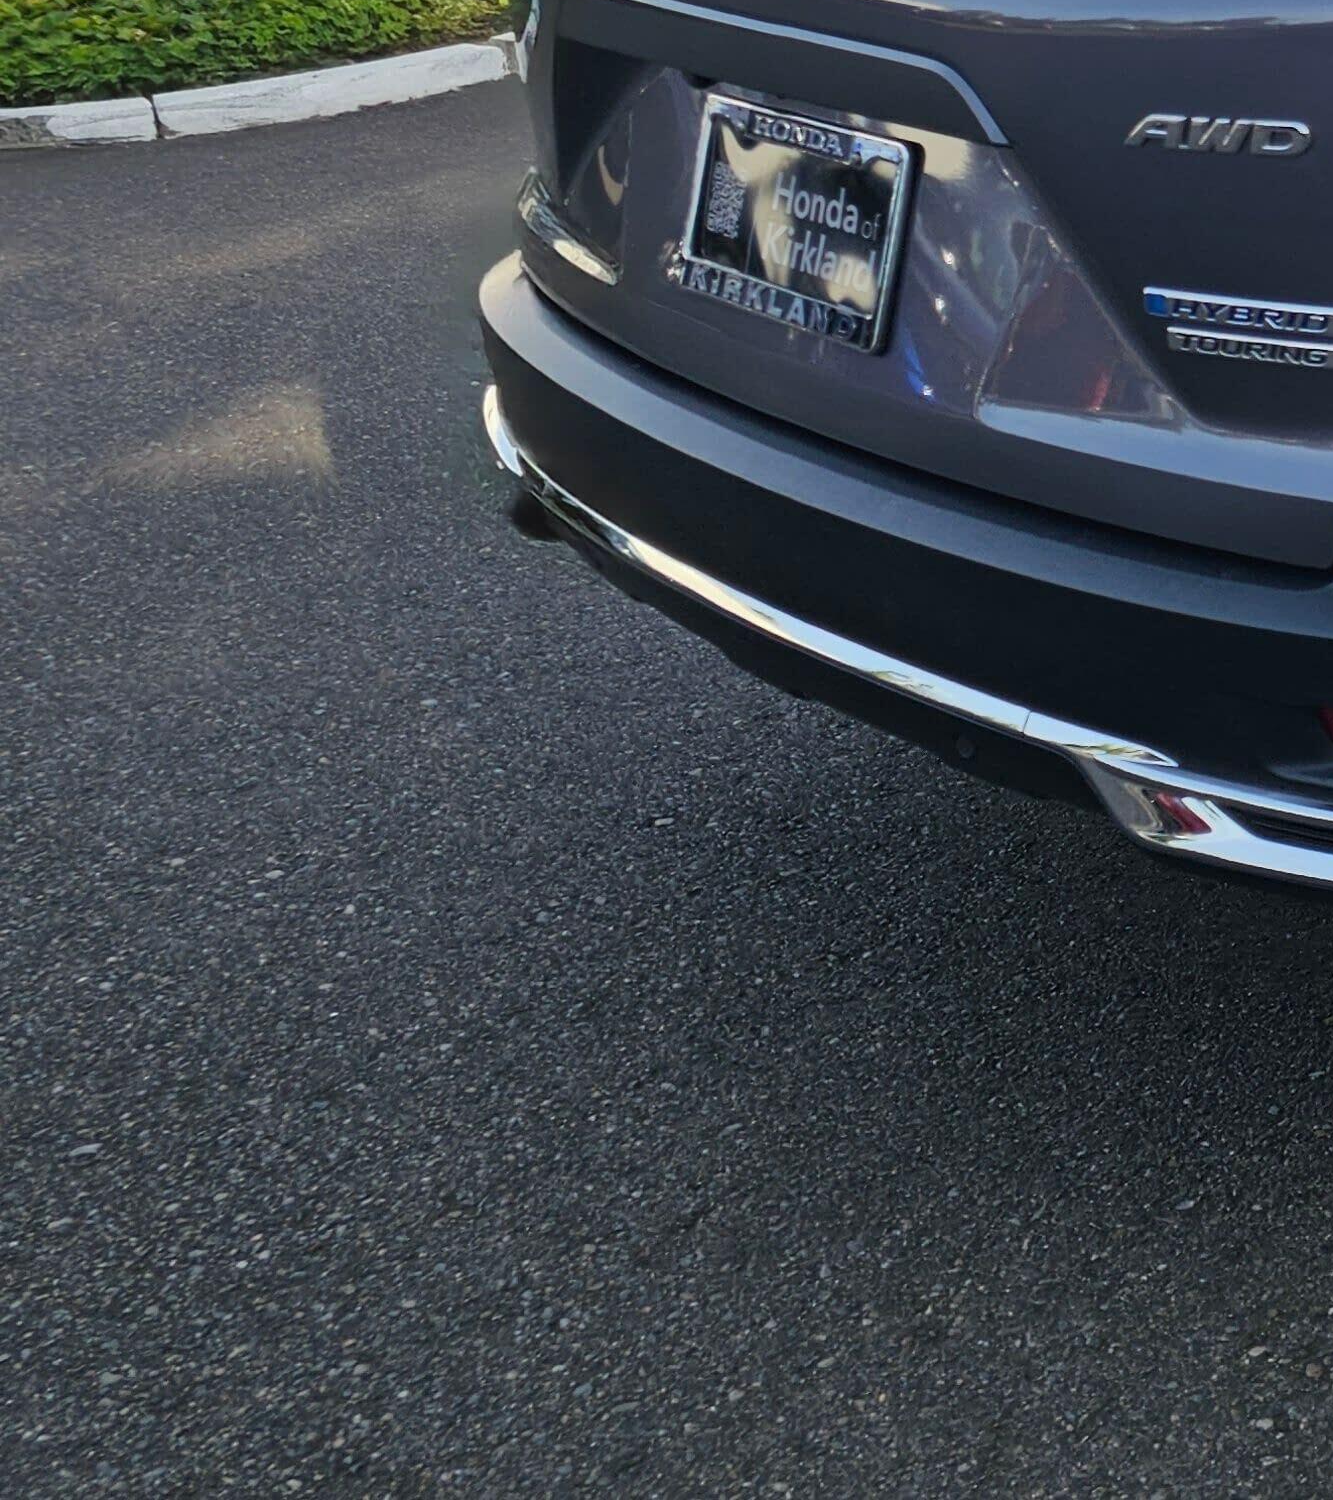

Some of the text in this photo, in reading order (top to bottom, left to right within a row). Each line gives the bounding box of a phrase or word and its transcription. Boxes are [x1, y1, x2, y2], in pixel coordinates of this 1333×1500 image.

[753, 115, 842, 156] HONDA
[1124, 113, 1312, 155] AWD
[771, 171, 881, 240] Honda of
[761, 220, 876, 294] Kirkland
[689, 266, 857, 339] KIRKLAND
[1171, 298, 1329, 333] HYBRID
[1176, 334, 1329, 367] TOURING
